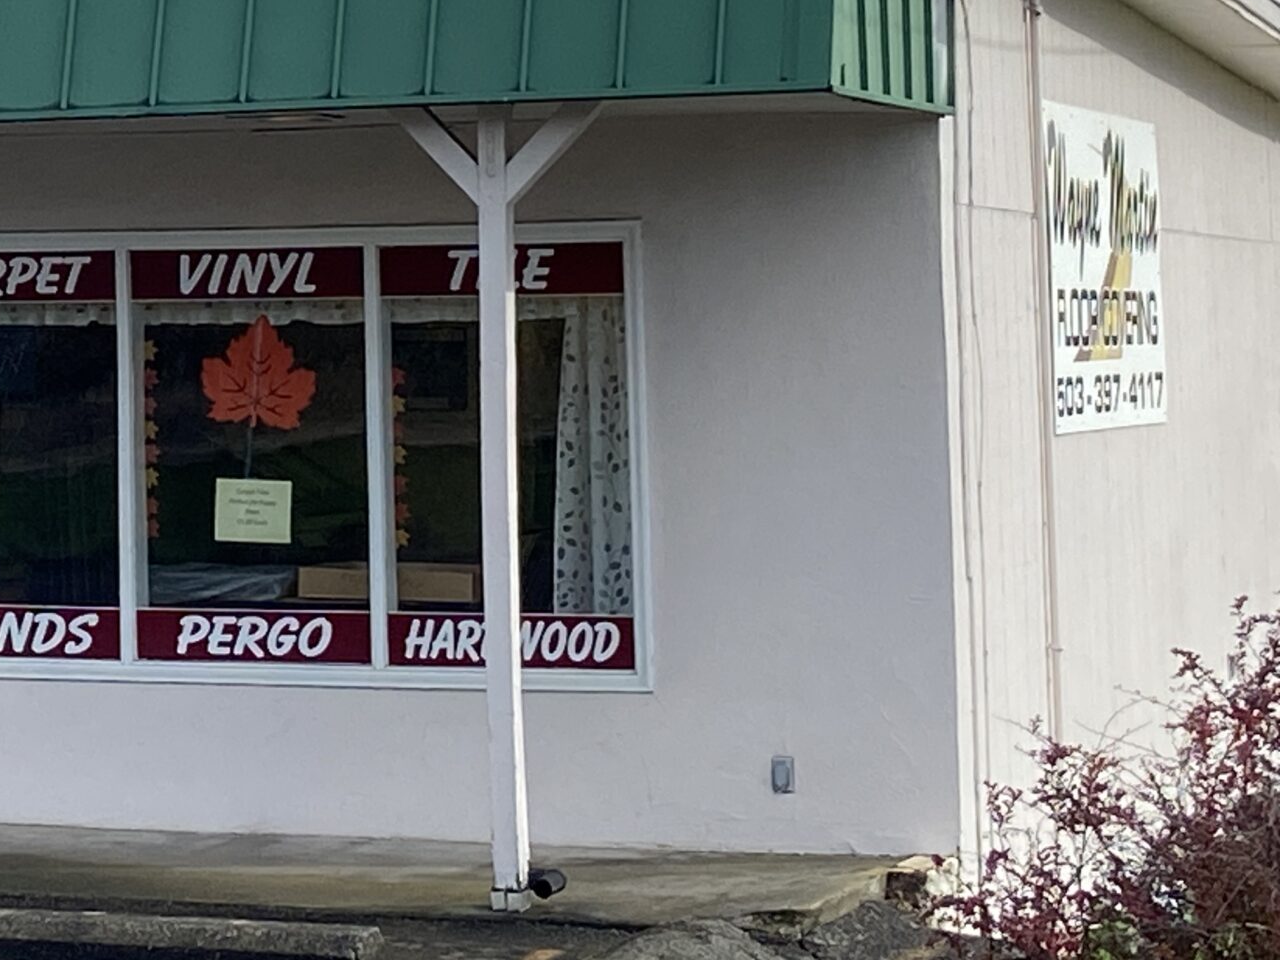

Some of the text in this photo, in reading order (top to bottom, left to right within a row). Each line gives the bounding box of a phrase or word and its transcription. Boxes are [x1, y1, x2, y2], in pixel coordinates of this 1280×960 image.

[179, 252, 317, 294] VINYL
[447, 248, 555, 291] TE
[176, 614, 333, 658] PERGO
[404, 618, 621, 662] HARWOOD
